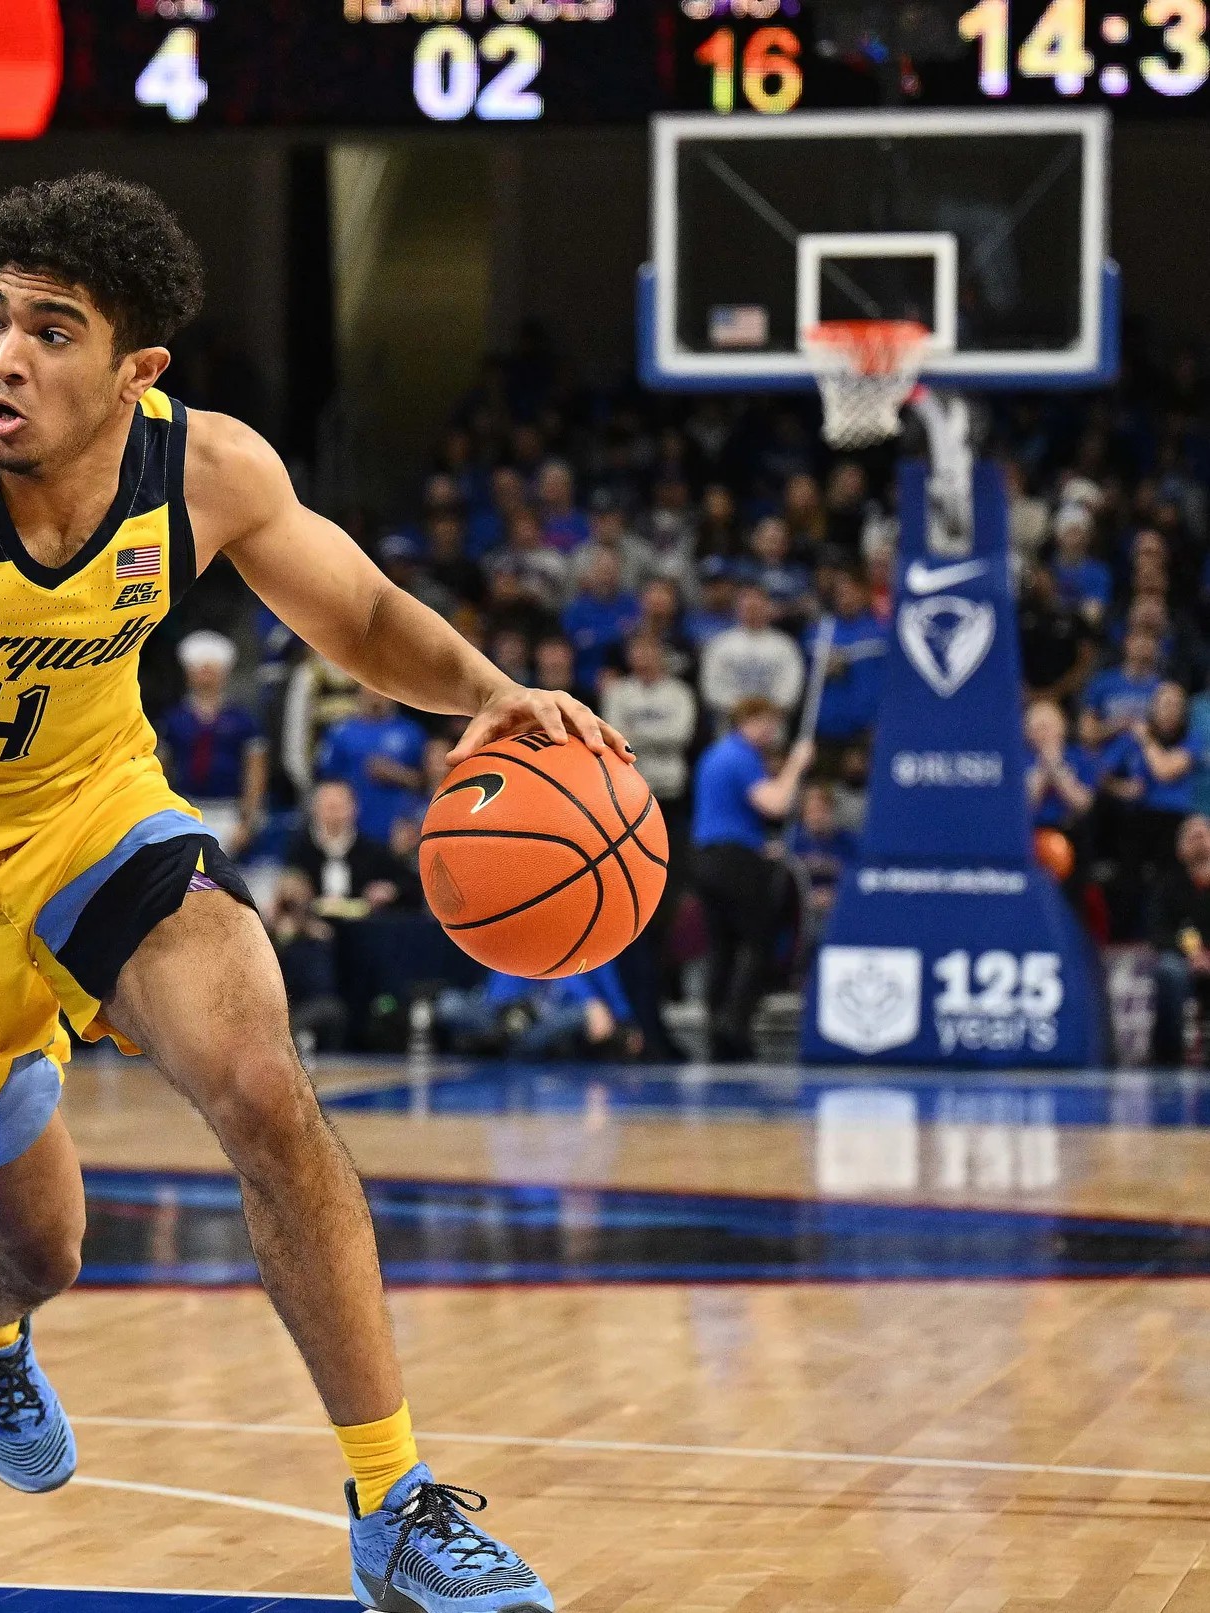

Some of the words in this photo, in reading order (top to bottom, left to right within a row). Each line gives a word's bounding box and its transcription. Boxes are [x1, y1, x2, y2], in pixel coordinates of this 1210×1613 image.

[134, 26, 208, 123] 4
[412, 24, 544, 121] 02
[694, 25, 803, 115] 16
[115, 589, 163, 605] EAST
[120, 581, 156, 595] BIG
[932, 949, 1064, 1017] 125
